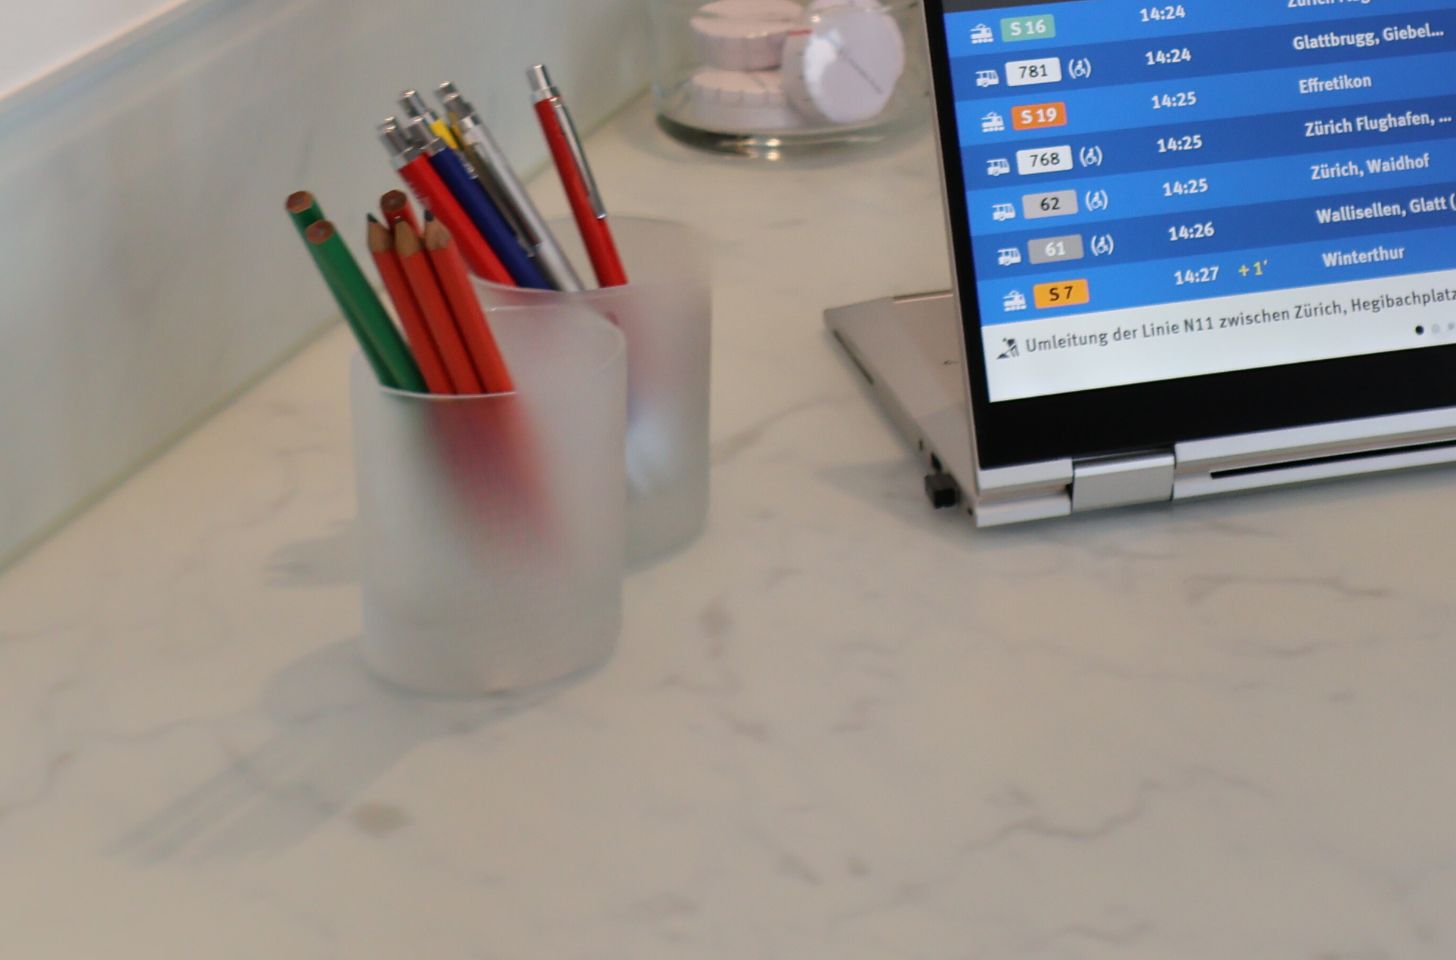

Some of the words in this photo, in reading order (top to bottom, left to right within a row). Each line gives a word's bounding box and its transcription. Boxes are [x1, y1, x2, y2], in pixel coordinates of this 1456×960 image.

[1140, 6, 1186, 22] 14:24
[1025, 19, 1046, 35] 16
[1293, 32, 1379, 49] Glattbrugg,
[1145, 49, 1192, 65] 14:24
[1019, 65, 1047, 78] 781
[1299, 73, 1372, 94] Effretikon
[1152, 91, 1197, 108] 14:25
[1035, 108, 1057, 123] 19
[1305, 117, 1353, 137] Zürich
[1356, 112, 1434, 132] Flughafen,
[1157, 135, 1203, 152] 14:25
[1029, 152, 1060, 167] 768
[1311, 161, 1364, 179] Zürich,
[1366, 153, 1431, 174] Waidhof
[1163, 179, 1209, 196] 14:25
[1041, 197, 1059, 211] 62
[1316, 203, 1407, 223] Wallisellen,
[1409, 195, 1447, 213] Glatt
[1169, 222, 1215, 240] 14:26
[1045, 241, 1066, 256] 61
[1322, 247, 1405, 268] Winterthur
[1175, 267, 1220, 284] 14:27
[1026, 333, 1108, 352] Umleitung
[1113, 328, 1136, 341] der
[1142, 322, 1179, 337] Linie
[1184, 317, 1214, 332] N11
[1220, 309, 1289, 328] zwischen
[1295, 301, 1347, 319] Zürich,
